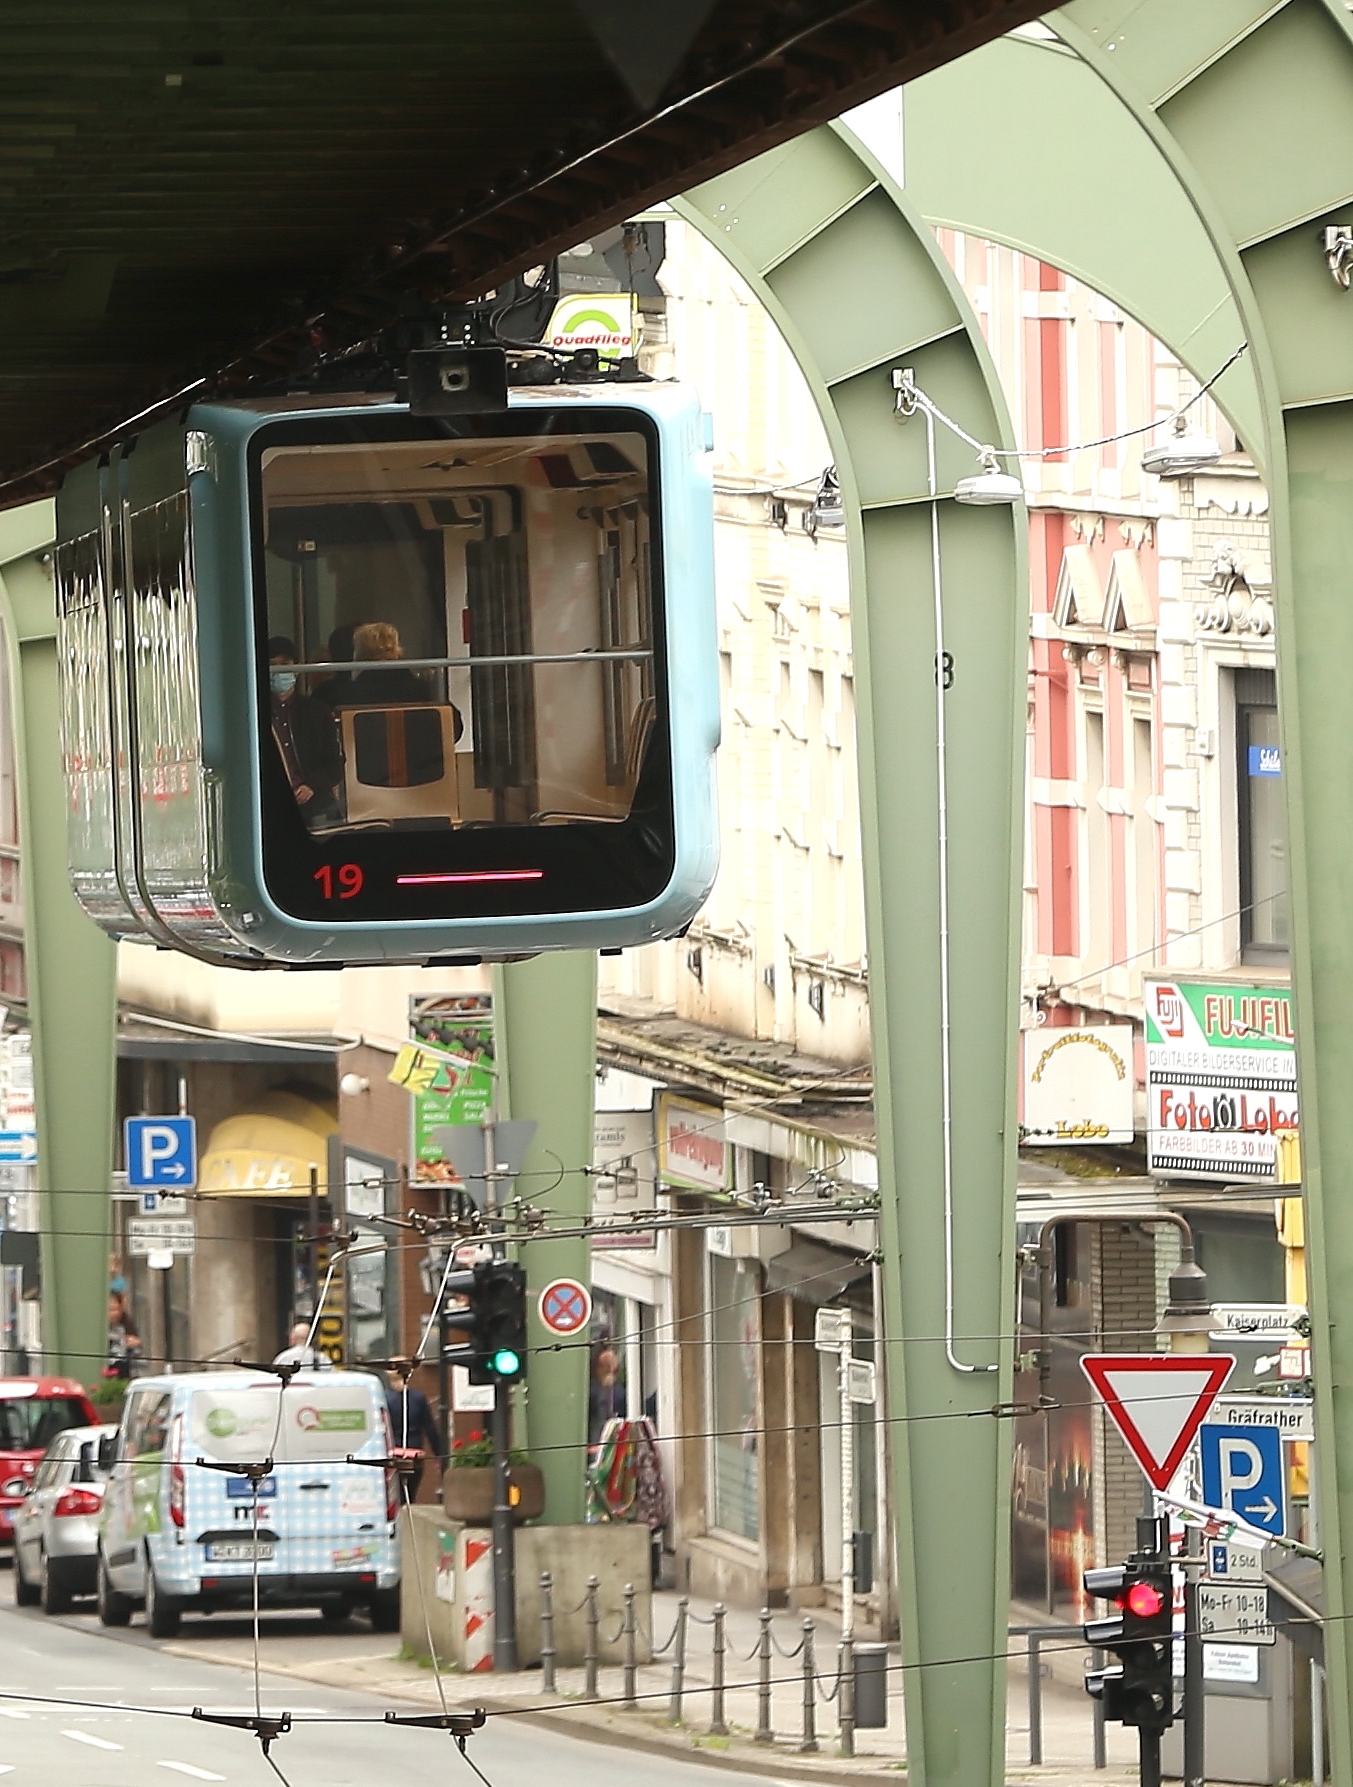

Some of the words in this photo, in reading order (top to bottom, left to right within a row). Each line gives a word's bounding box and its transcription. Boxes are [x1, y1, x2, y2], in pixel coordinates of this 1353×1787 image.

[553, 334, 632, 347] Quadflieg
[313, 864, 364, 899] 19
[1149, 1050, 1200, 1068] DIGITALER
[1202, 1052, 1279, 1073] BILDERSERVICE
[1160, 1089, 1212, 1130] Foto
[1055, 1119, 1110, 1139] Lobo
[140, 1125, 180, 1180] P
[1159, 1135, 1222, 1154] FARBBILDER
[1241, 1141, 1255, 1156] 30
[1227, 1314, 1289, 1331] Kaiserplatz
[1228, 1408, 1303, 1428] Gräfrather
[1219, 1437, 1263, 1511] P
[1231, 1554, 1238, 1567] 2
[1201, 1593, 1233, 1610] Mo-Fr
[1236, 1594, 1265, 1613] 10-18
[1201, 1616, 1215, 1632] Sa
